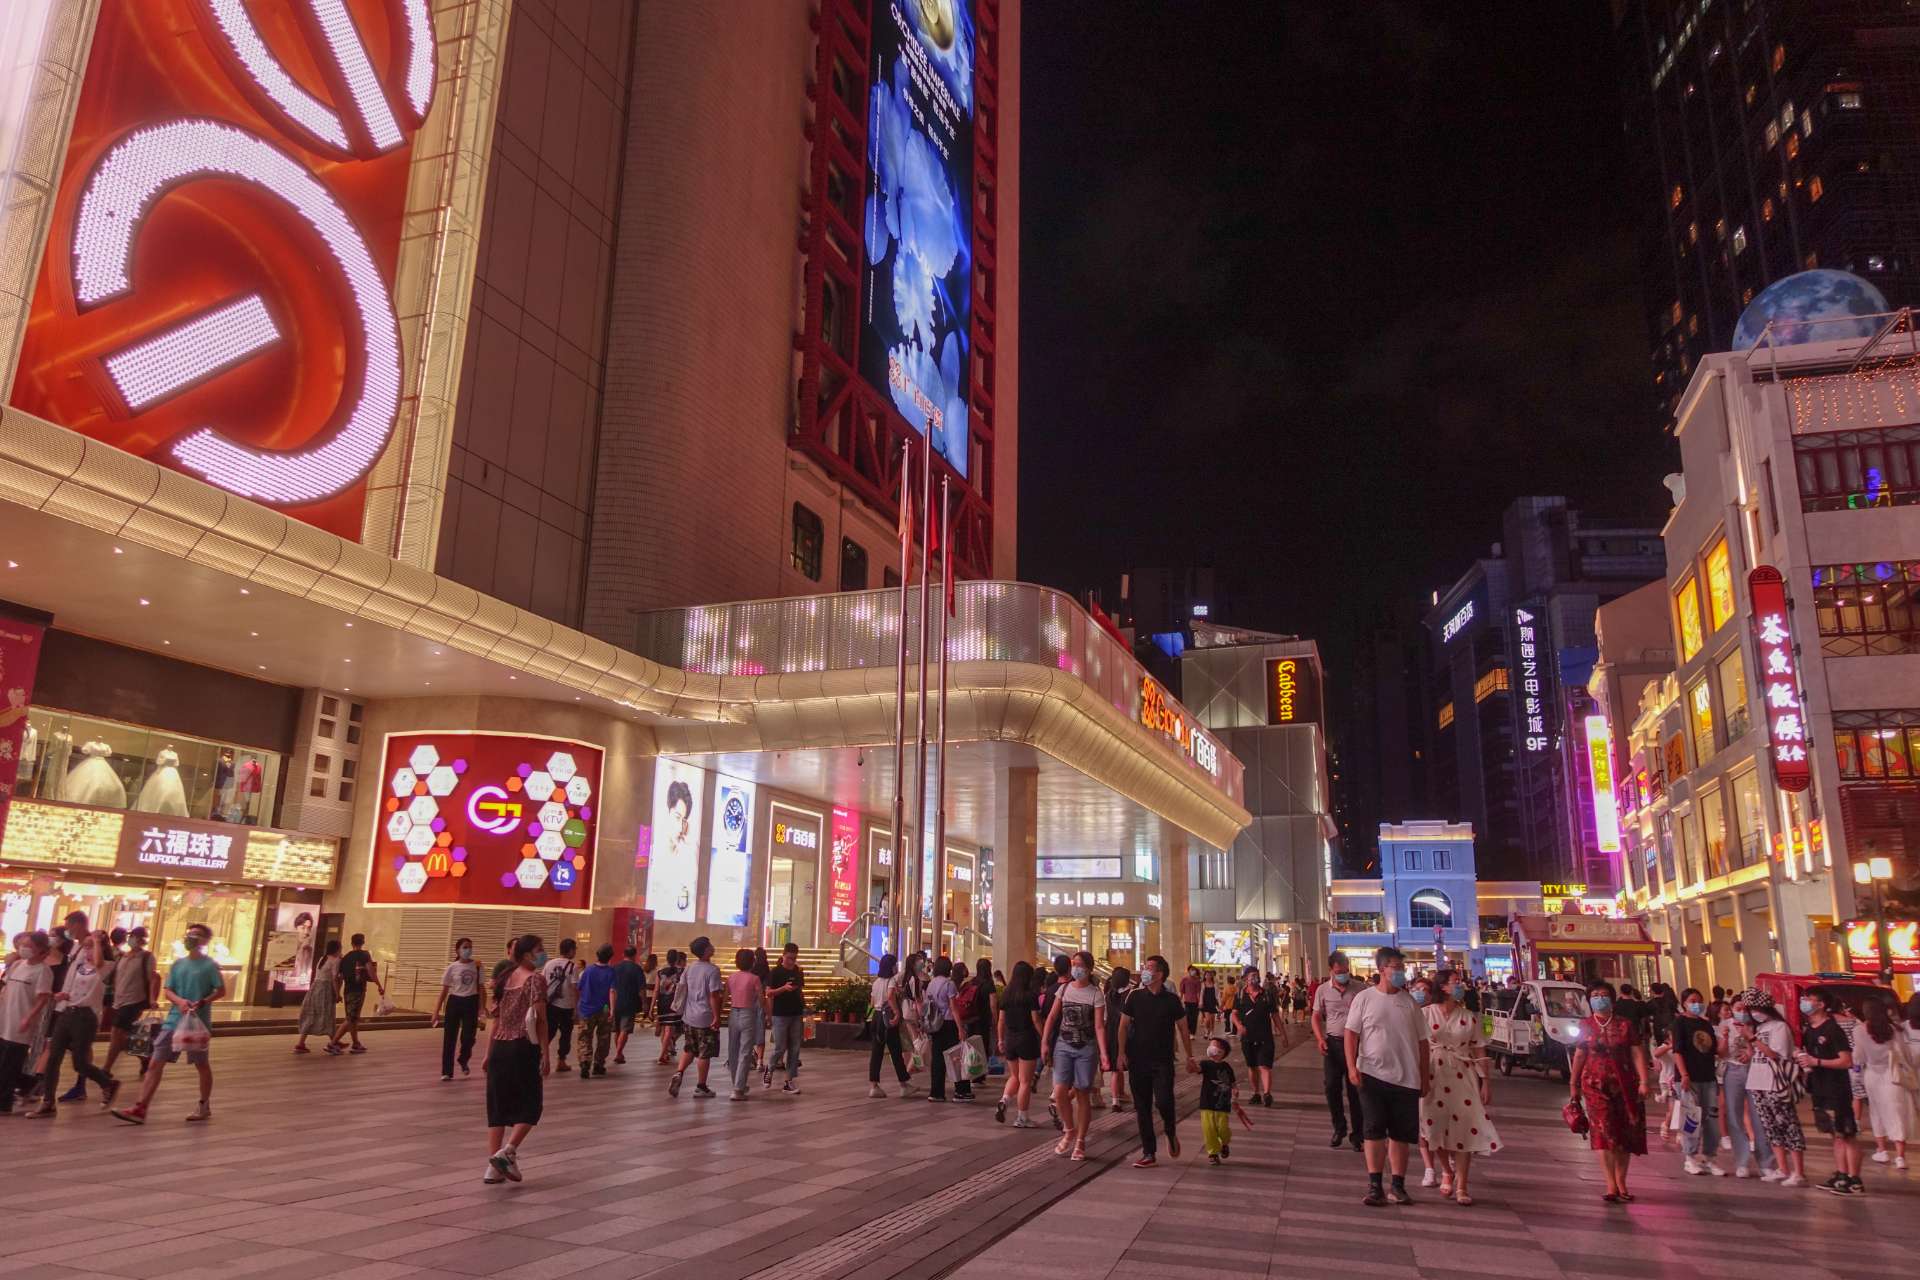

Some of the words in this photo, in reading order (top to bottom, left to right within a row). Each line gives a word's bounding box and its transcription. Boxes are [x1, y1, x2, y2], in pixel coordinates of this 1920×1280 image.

[890, 2, 928, 69] ORCHIDÉE
[1276, 660, 1296, 721] Cabbeen
[1526, 737, 1548, 751] 9F
[180, 857, 229, 869] JEWELLERY
[1036, 892, 1074, 905] TSL
